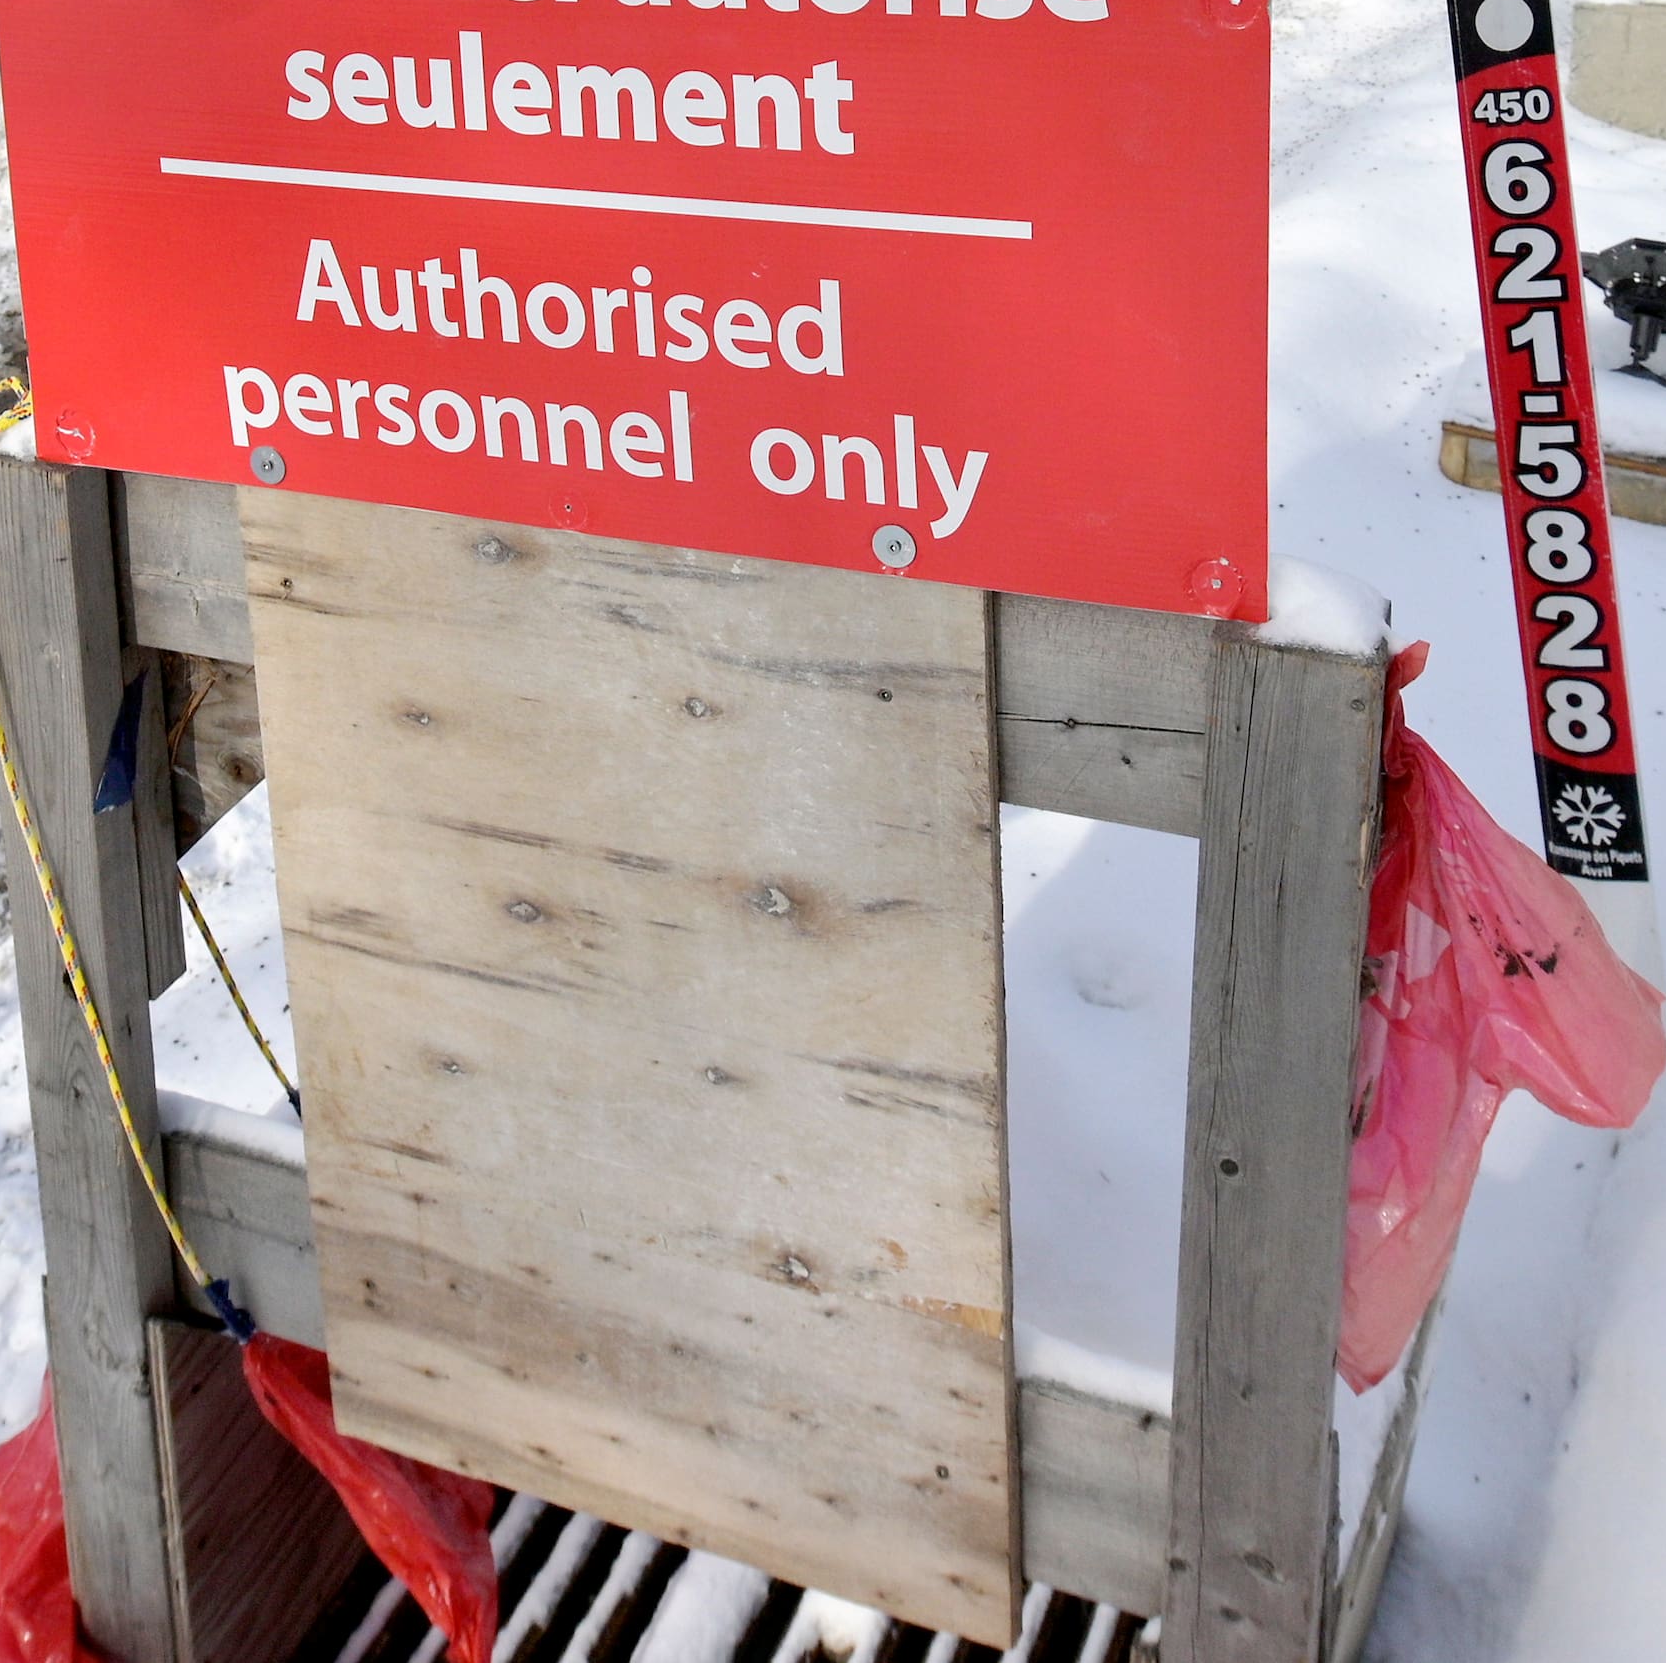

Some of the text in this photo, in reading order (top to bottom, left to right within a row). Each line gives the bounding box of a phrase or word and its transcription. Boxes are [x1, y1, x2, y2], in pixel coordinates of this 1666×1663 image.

[285, 30, 855, 155] seulement
[1472, 88, 1552, 124] 450
[296, 238, 844, 377] Authorised
[223, 365, 989, 539] personnel only
[1482, 139, 1615, 754] 621-5828
[1581, 863, 1613, 878] Avril
